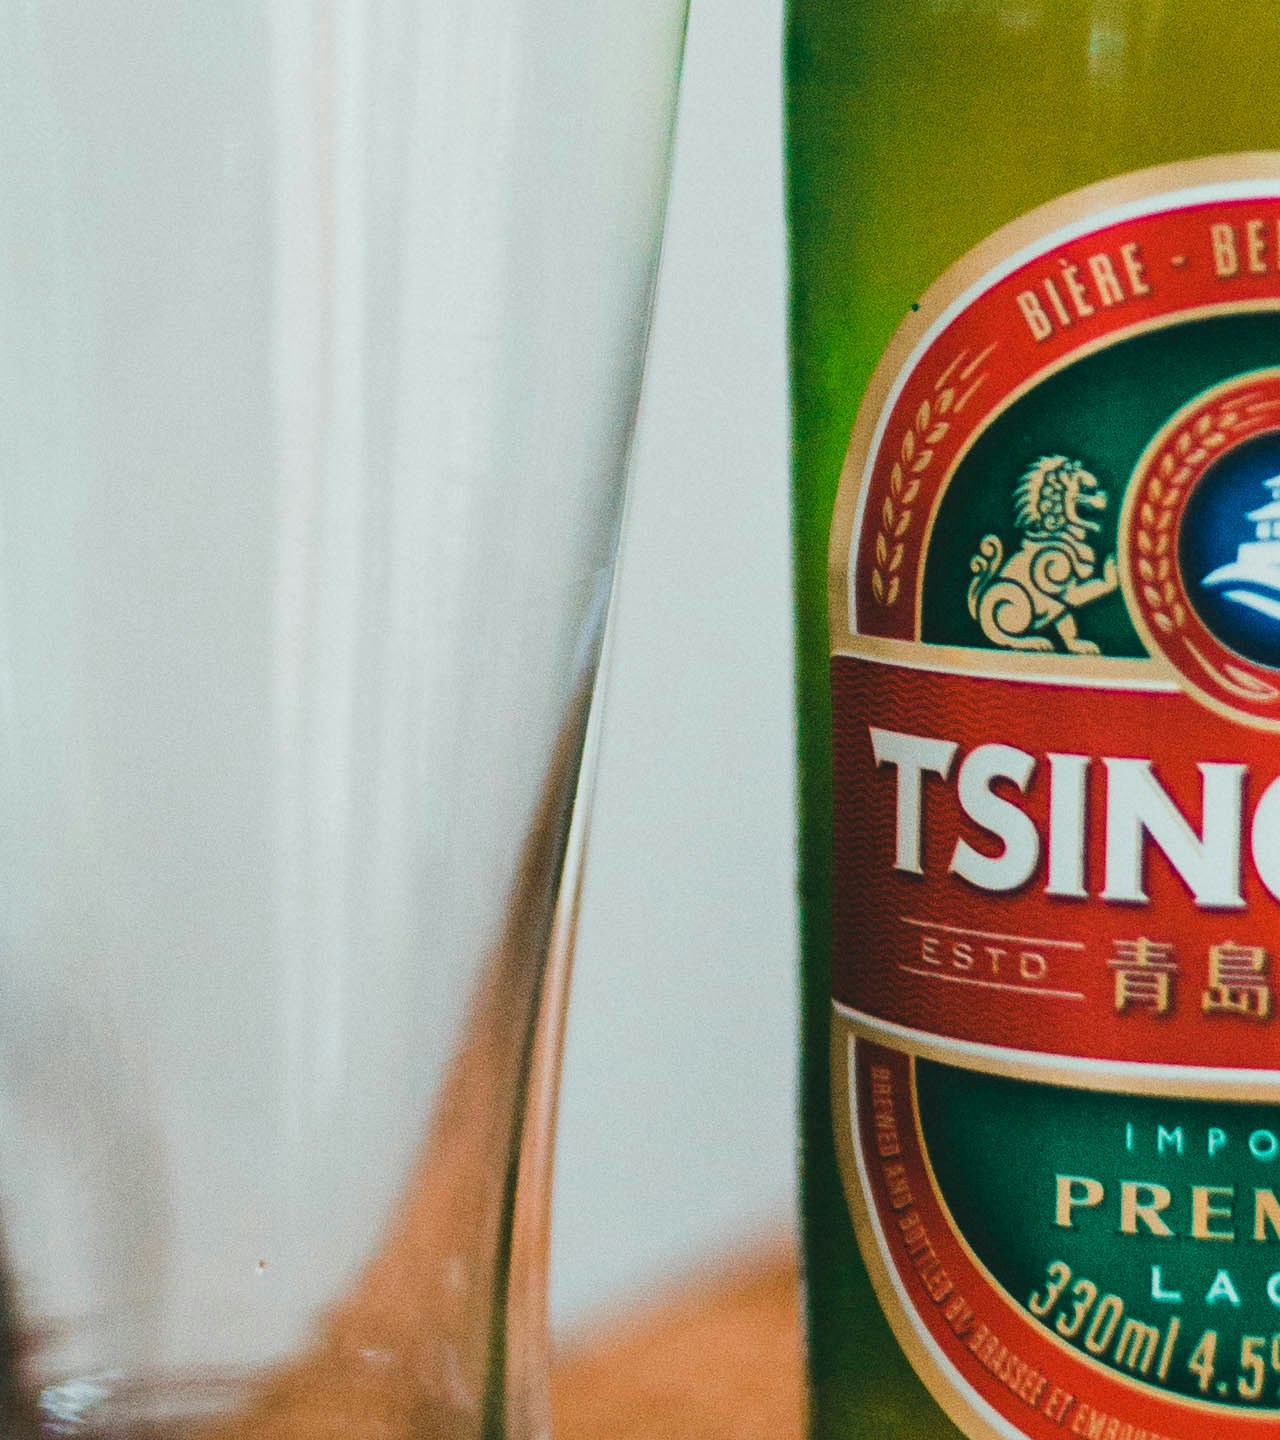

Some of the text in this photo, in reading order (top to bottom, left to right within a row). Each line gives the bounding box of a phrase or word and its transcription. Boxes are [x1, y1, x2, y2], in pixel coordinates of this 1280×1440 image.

[1017, 238, 1151, 343] BIÈRE
[920, 937, 1050, 982] ESTD
[1027, 1260, 1181, 1382] 330ml
